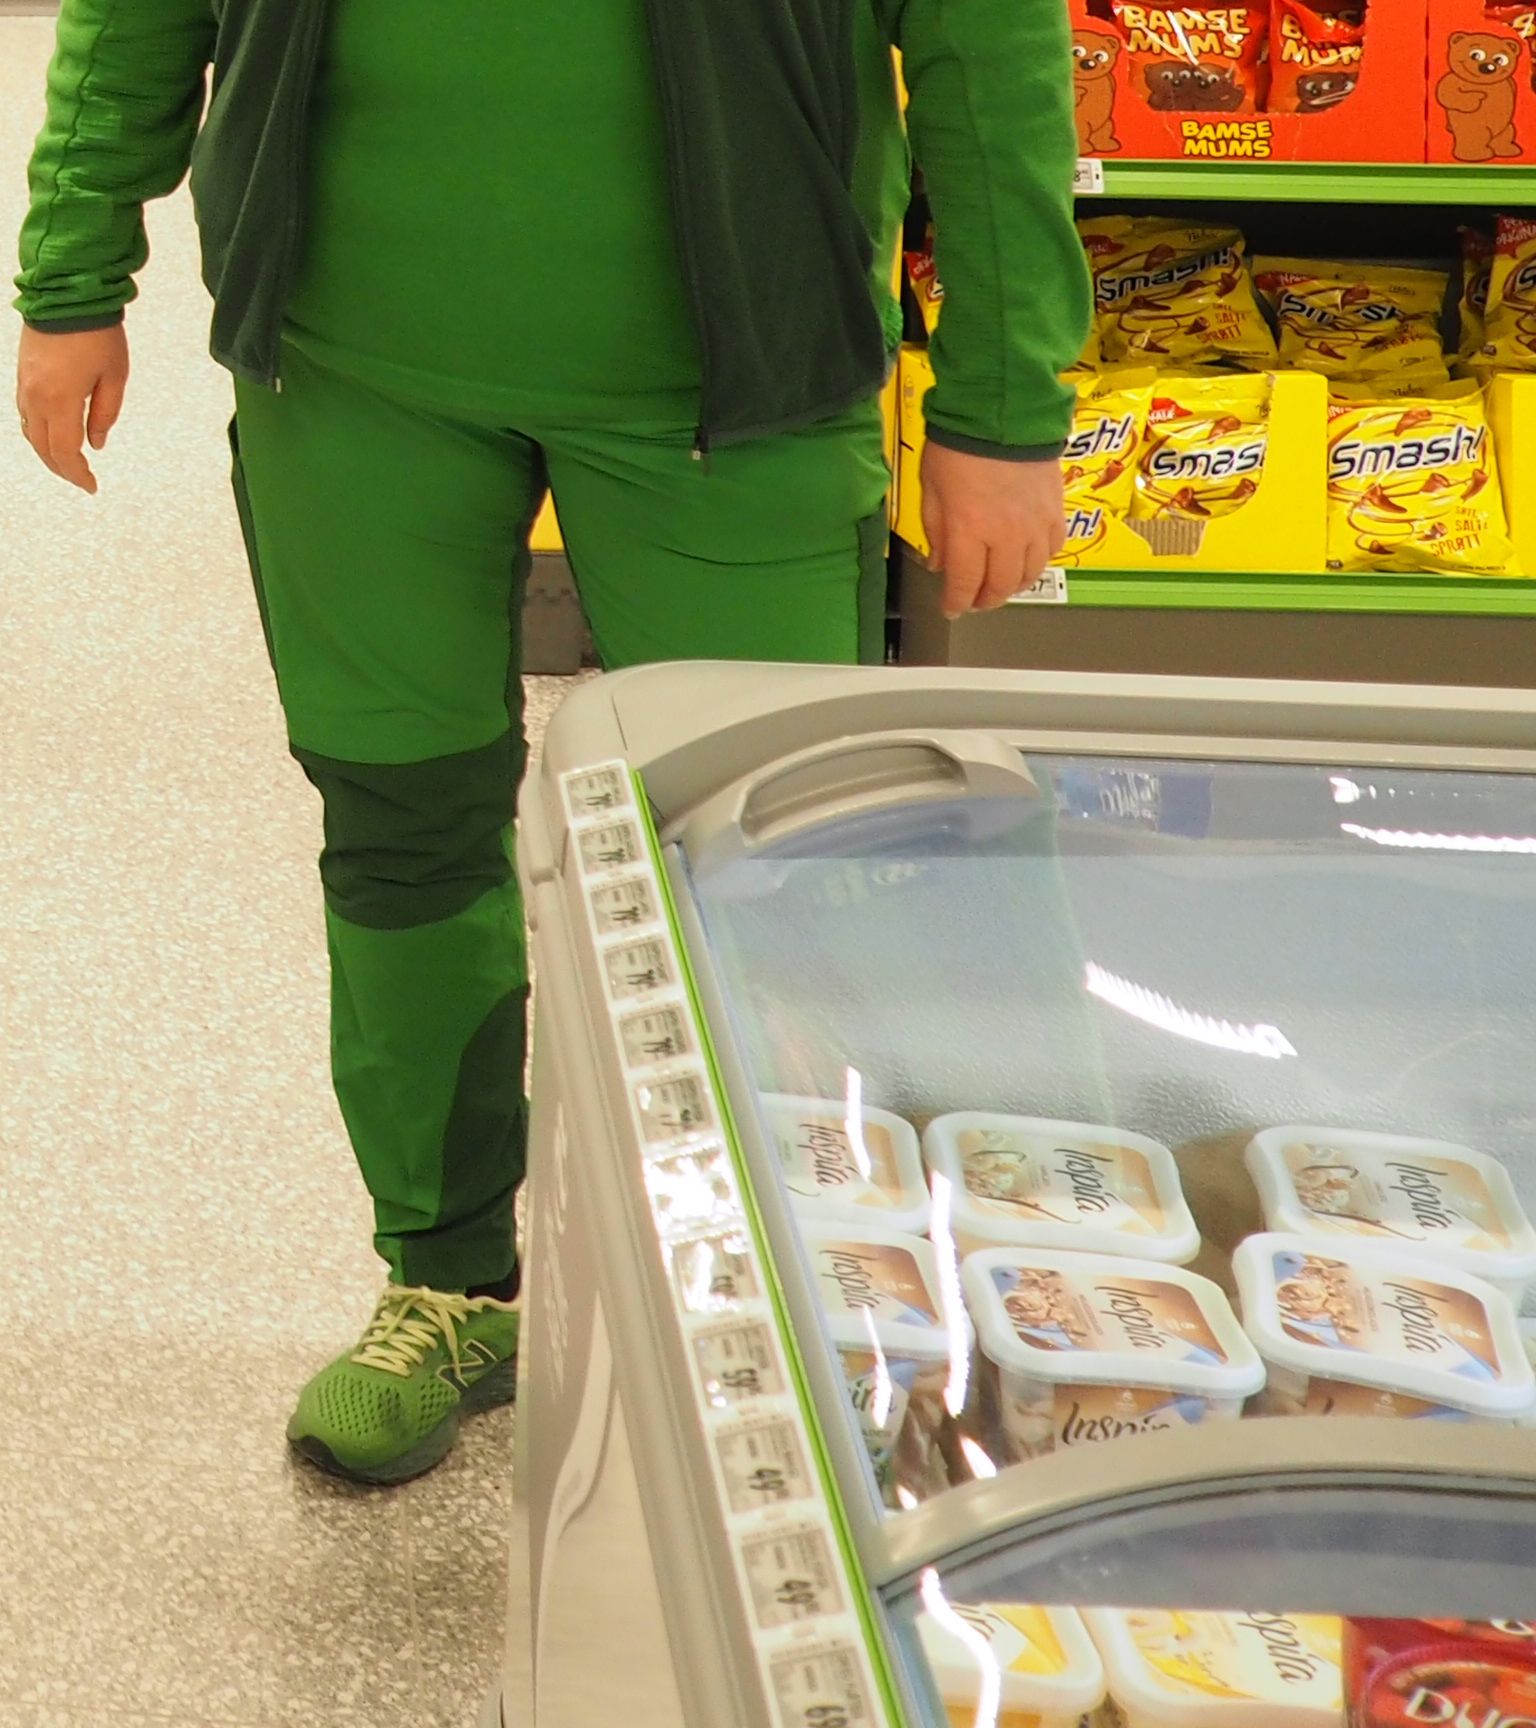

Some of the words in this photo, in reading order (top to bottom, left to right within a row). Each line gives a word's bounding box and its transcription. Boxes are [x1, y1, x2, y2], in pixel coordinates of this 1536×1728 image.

[1123, 6, 1251, 36] BAMSE
[1181, 120, 1272, 140] BAMSE
[1183, 139, 1271, 158] MUMS
[1329, 425, 1486, 480] Smash!
